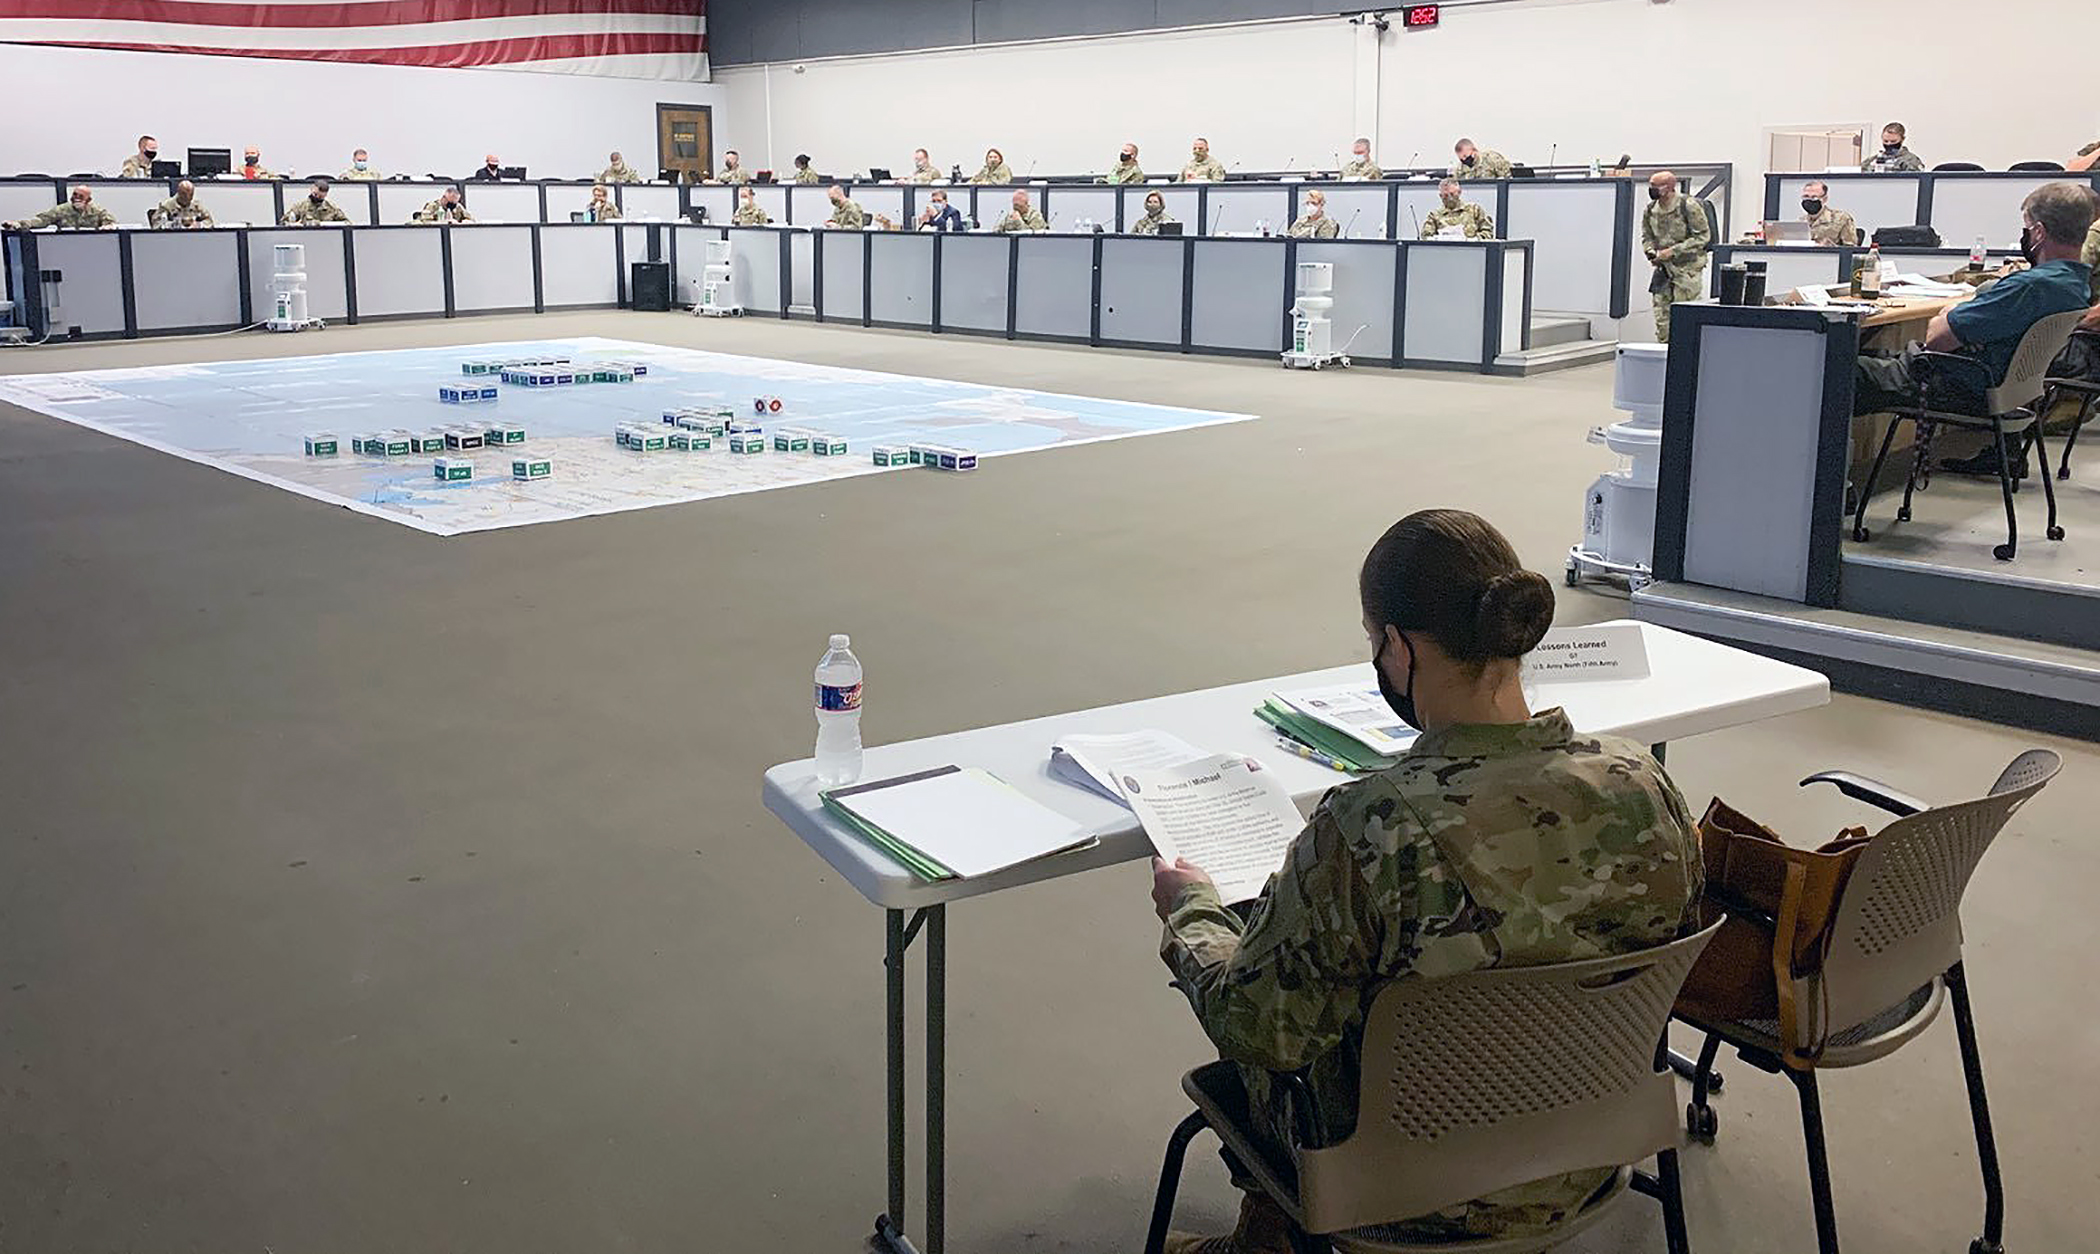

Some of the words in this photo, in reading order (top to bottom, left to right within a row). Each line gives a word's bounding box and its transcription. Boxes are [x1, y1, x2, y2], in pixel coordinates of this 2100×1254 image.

[1573, 640, 1607, 649] Learned
[1546, 662, 1562, 670] Army
[1564, 661, 1580, 669] North
[1192, 772, 1221, 785] Michael
